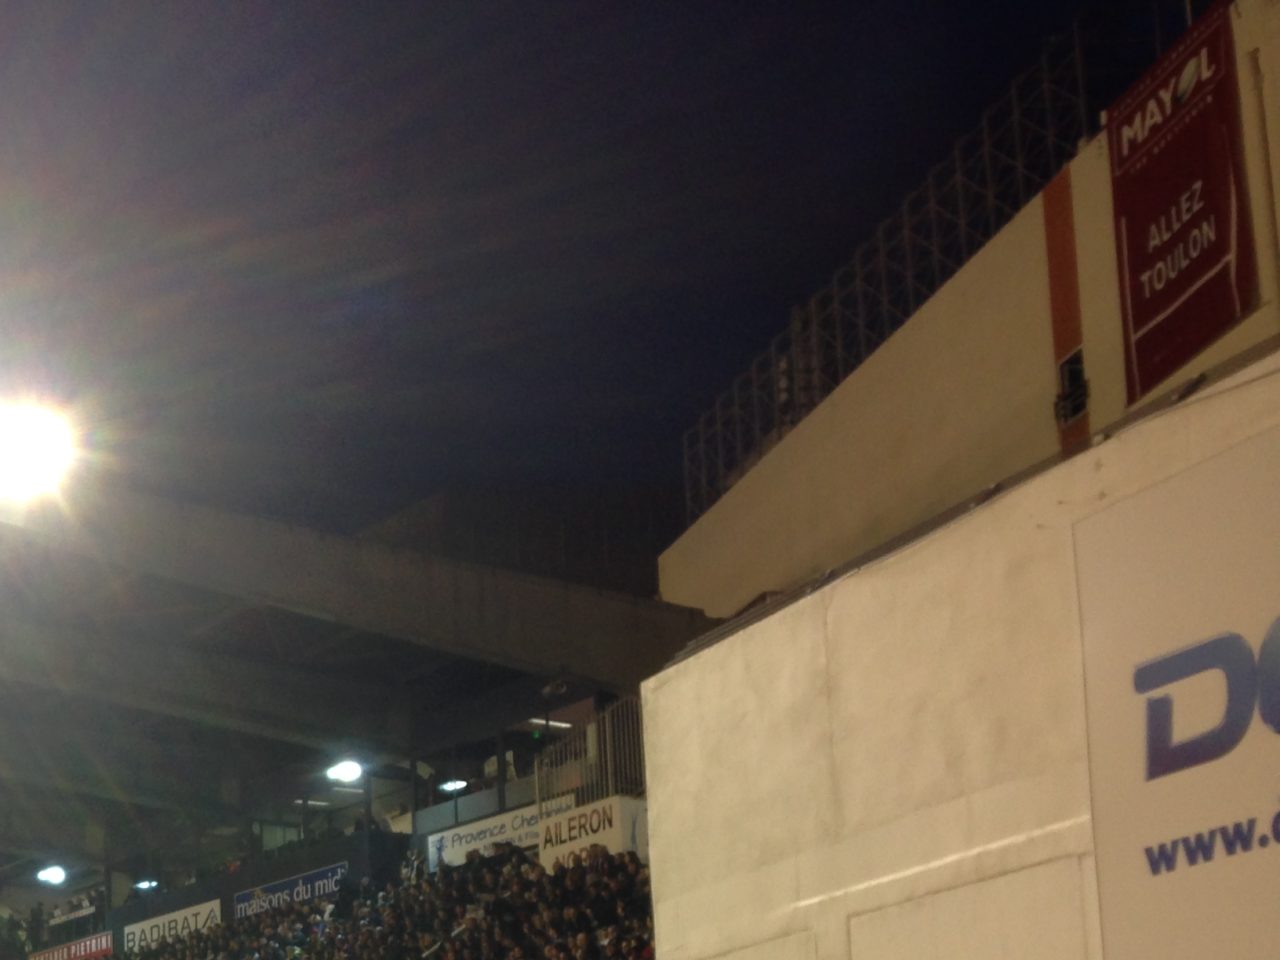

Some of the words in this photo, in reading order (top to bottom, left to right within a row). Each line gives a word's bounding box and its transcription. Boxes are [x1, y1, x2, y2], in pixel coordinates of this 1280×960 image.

[1121, 47, 1216, 157] MAYOL
[1146, 180, 1204, 251] ALLEZ
[1139, 215, 1217, 299] TOULON
[543, 804, 613, 850] AILERON
[293, 880, 311, 900] du
